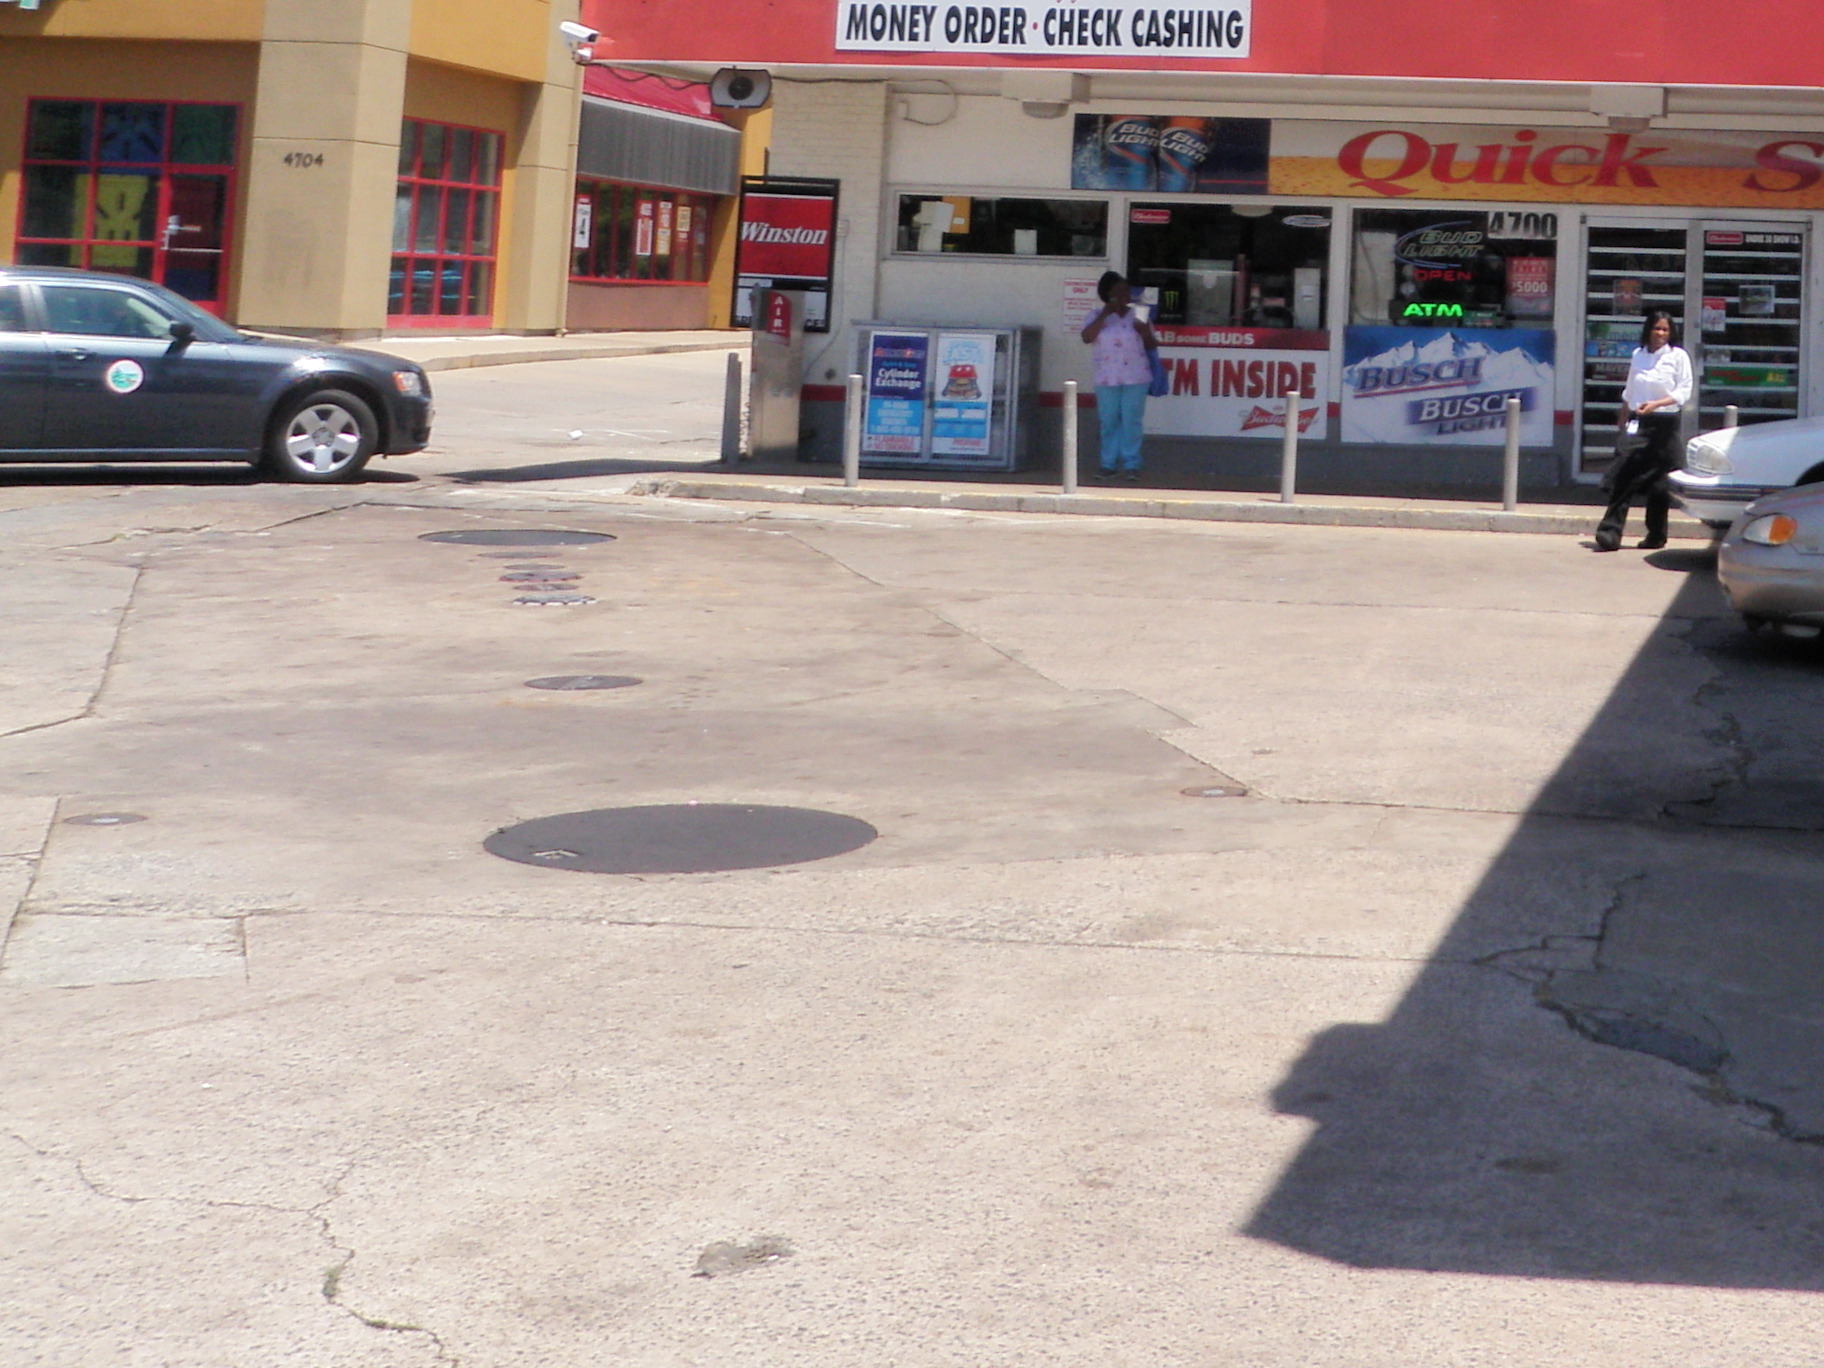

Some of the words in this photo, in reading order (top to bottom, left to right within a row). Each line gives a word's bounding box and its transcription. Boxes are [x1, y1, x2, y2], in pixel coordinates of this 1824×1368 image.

[846, 3, 937, 43] MONEY
[945, 5, 1026, 46] ORDER
[1044, 7, 1122, 47] CHECK
[1131, 9, 1244, 49] CASHING
[284, 152, 324, 169] 4704
[1338, 129, 1668, 197] Quick
[741, 221, 828, 245] Winston
[1489, 212, 1558, 239] 4700
[1420, 230, 1483, 244] BUD
[1402, 243, 1484, 258] LIGHT
[1413, 270, 1472, 281] OPEN
[1403, 303, 1463, 317] ATM
[1208, 332, 1254, 345] BUDS
[1211, 359, 1316, 399] INSIDE
[1356, 356, 1485, 391] BUSCH
[875, 377, 921, 389] Exchange
